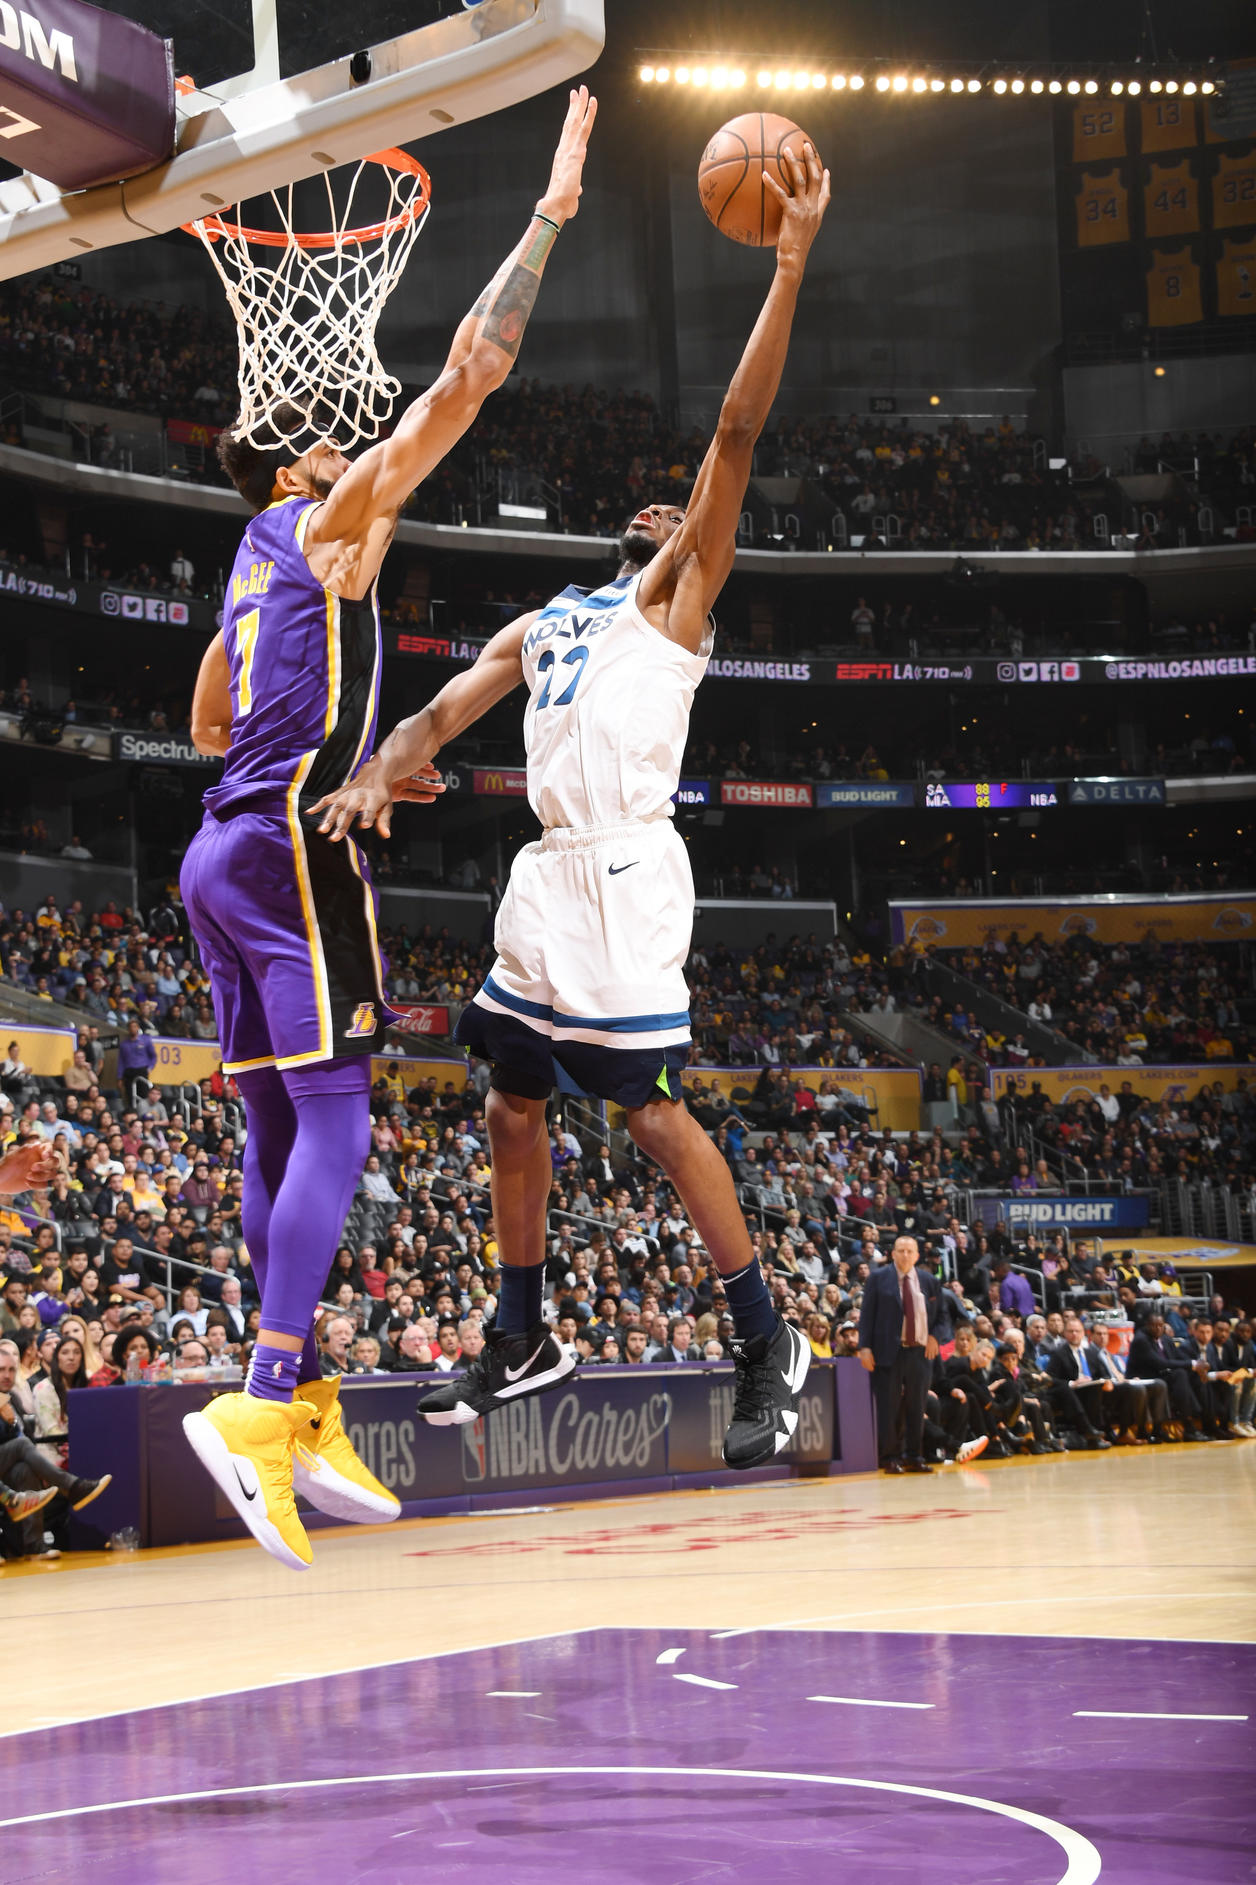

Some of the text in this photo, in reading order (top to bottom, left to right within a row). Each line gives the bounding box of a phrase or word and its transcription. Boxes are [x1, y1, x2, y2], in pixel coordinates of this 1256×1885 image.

[1082, 111, 1115, 136] 52
[1157, 102, 1180, 127] 13
[1154, 187, 1187, 212] 44
[1223, 178, 1256, 204] 32
[1086, 198, 1118, 221] 34
[1167, 276, 1180, 298] 8
[523, 611, 619, 656] WOLVES
[398, 634, 475, 660] ESPN LA
[235, 606, 260, 718] 7
[837, 664, 892, 680] ESPN
[893, 664, 915, 680] LA
[535, 645, 589, 712] 22
[121, 735, 215, 763] Spectru
[678, 791, 705, 804] NBA
[722, 784, 810, 804] TOSHIBA
[832, 791, 898, 802] BUD LIGHT
[926, 784, 944, 796] SA
[1030, 794, 1057, 806] NBA
[1092, 785, 1162, 800] DELTA
[160, 1046, 182, 1065] 03
[1009, 1203, 1114, 1222] BUD LIGHT
[489, 1394, 547, 1479] NBA
[548, 1392, 672, 1476] Cares
